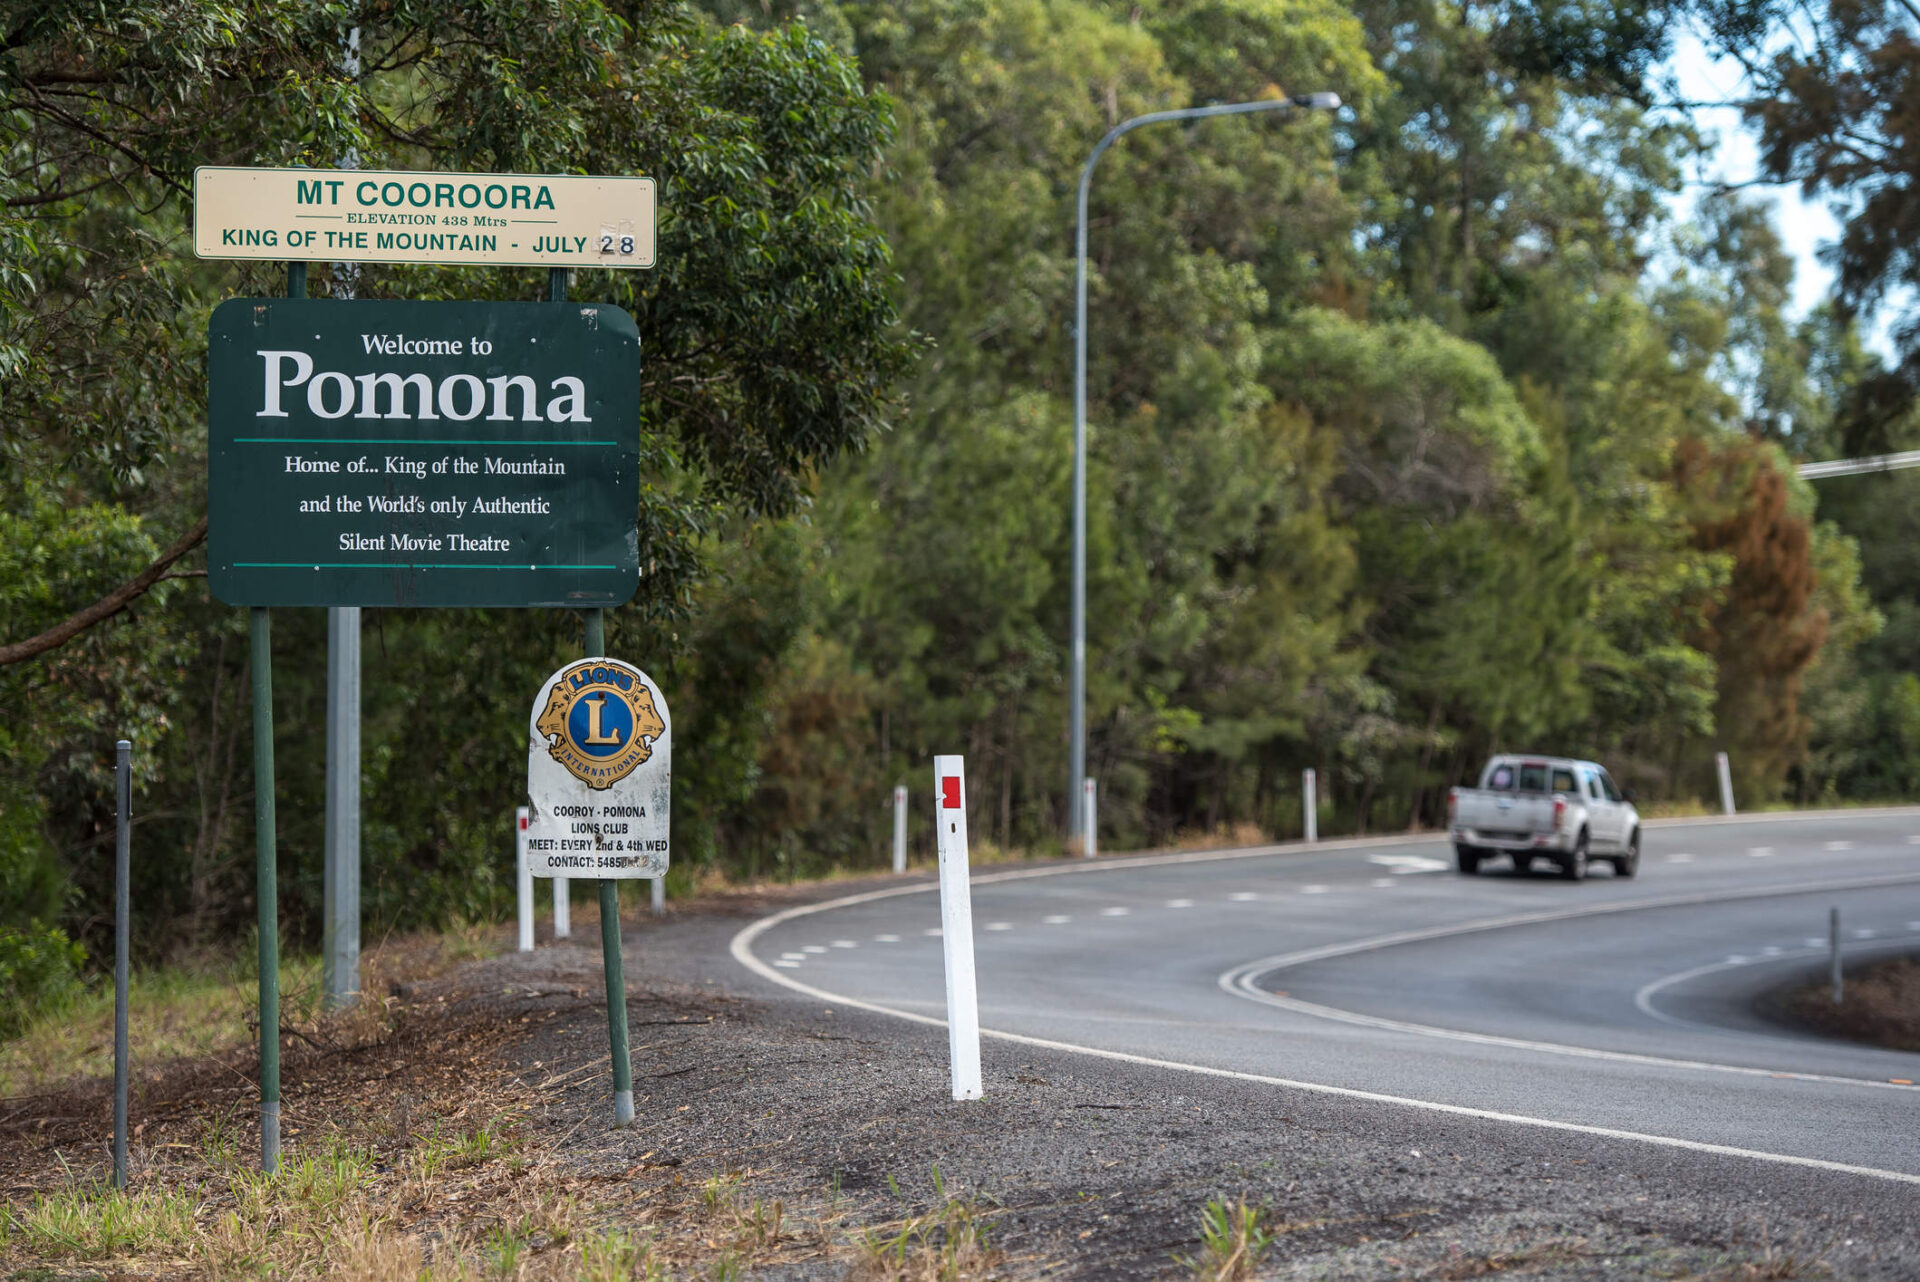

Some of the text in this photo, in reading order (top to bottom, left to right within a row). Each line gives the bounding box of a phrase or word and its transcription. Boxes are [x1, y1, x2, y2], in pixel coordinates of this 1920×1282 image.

[297, 180, 556, 210] MT COOROORA
[346, 213, 508, 227] ELEVATION 438 Mtrs
[222, 229, 278, 247] KING
[286, 230, 316, 248] OF
[324, 231, 368, 249] THE
[376, 232, 497, 252] MOUNTAIN
[532, 236, 587, 254] JULY
[600, 236, 635, 254] 28
[361, 334, 493, 356] Welcome to
[256, 349, 592, 423] Pomona
[285, 456, 340, 473] Home
[385, 456, 426, 479] King
[432, 456, 449, 475] of
[454, 457, 479, 475] the
[484, 457, 566, 475] Mountain
[300, 496, 331, 513] and
[336, 495, 363, 513] the
[430, 496, 466, 519] only
[472, 496, 550, 515] Authentic
[339, 533, 510, 552] Silent Movie Theatre
[569, 667, 634, 692] LIONS
[584, 699, 620, 744] L
[561, 749, 640, 777] INTERNATIONAL
[553, 806, 595, 818] COOROY
[603, 806, 646, 818] POMONA
[571, 823, 628, 834] LIONS CLUB
[528, 839, 668, 851] MEET: EVERY 2nd & 4th WED
[548, 856, 595, 868] CONTACT:
